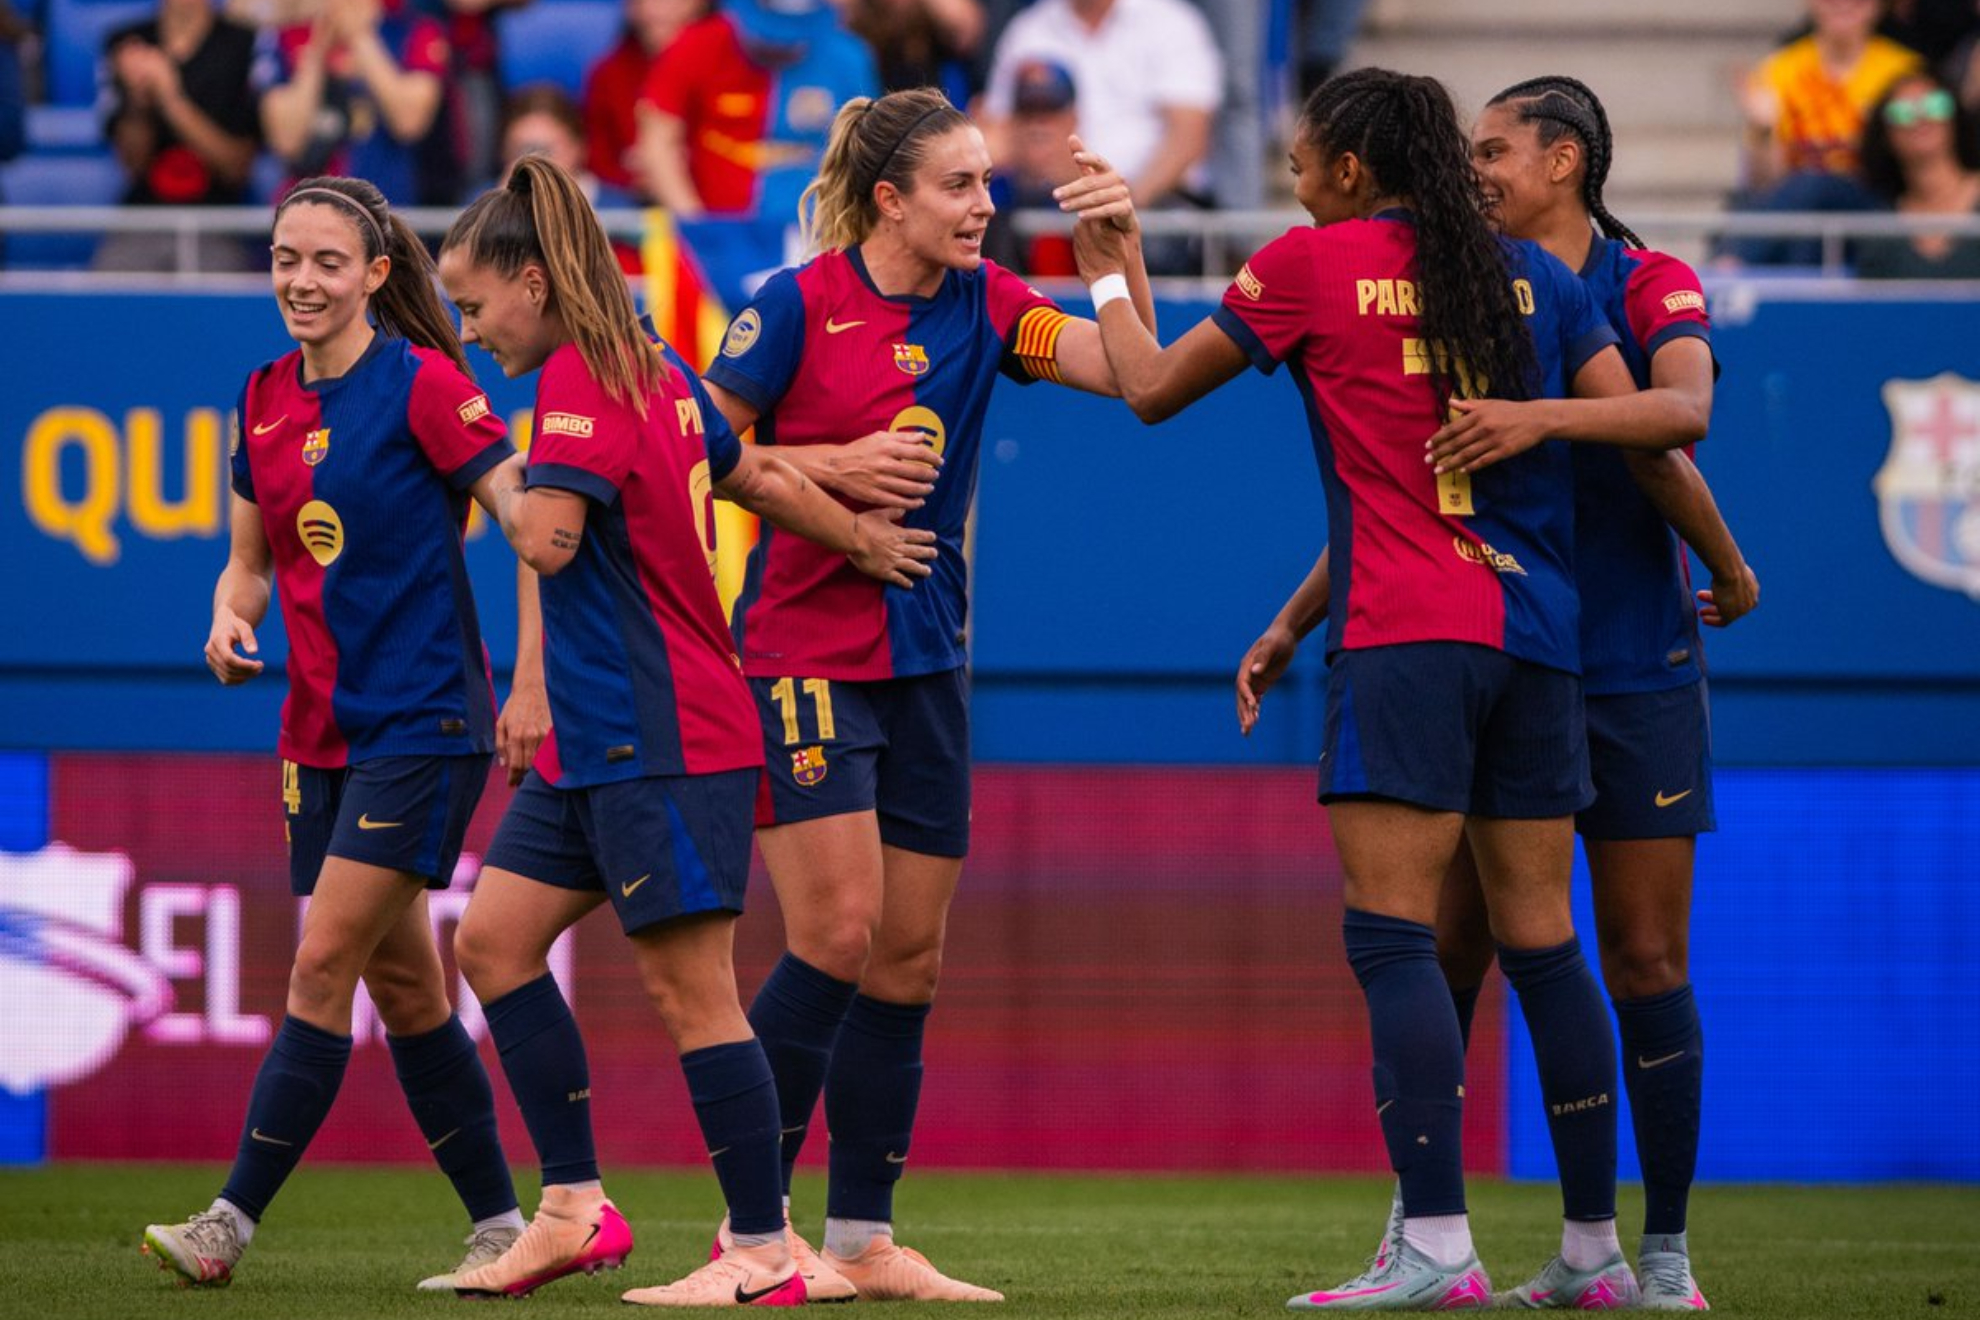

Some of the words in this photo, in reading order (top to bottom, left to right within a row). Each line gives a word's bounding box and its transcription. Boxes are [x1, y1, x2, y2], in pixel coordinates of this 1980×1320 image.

[543, 416, 593, 434] BIMBO
[771, 677, 835, 745] 11
[140, 884, 272, 1042] EL
